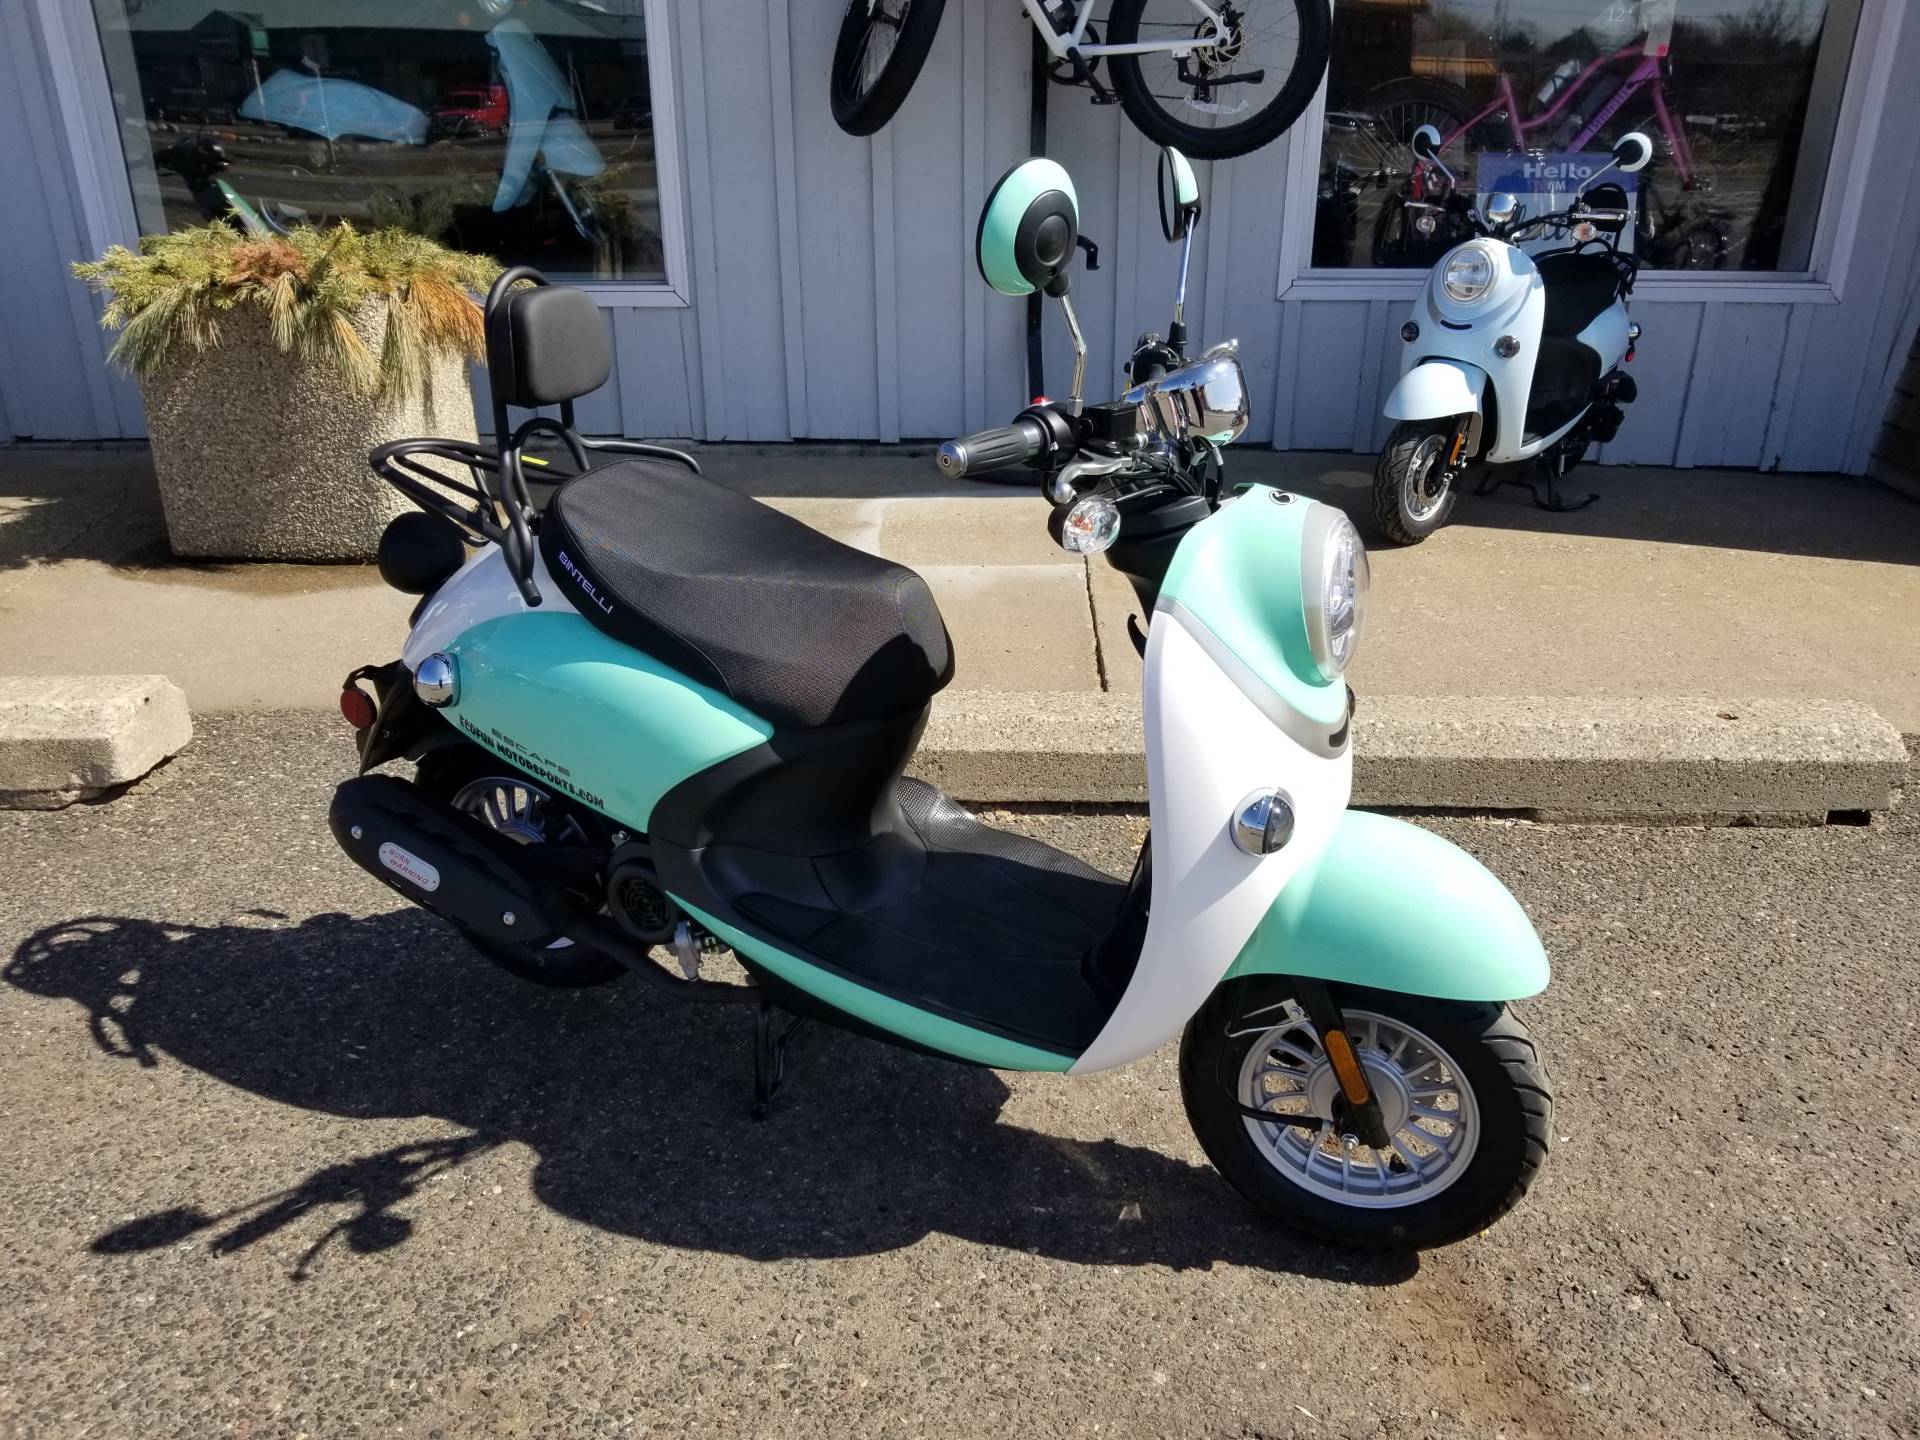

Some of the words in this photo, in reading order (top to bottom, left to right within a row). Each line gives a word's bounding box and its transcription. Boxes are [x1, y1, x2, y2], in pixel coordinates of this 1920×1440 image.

[1523, 162, 1592, 179] Hello
[559, 551, 613, 614] BINTELLI
[459, 714, 495, 748] ECOFUN
[497, 741, 605, 809] MOTORSPORTS.COM
[491, 727, 571, 777] ESCAPE
[388, 848, 411, 865] BURN
[390, 858, 430, 885] WARNING
